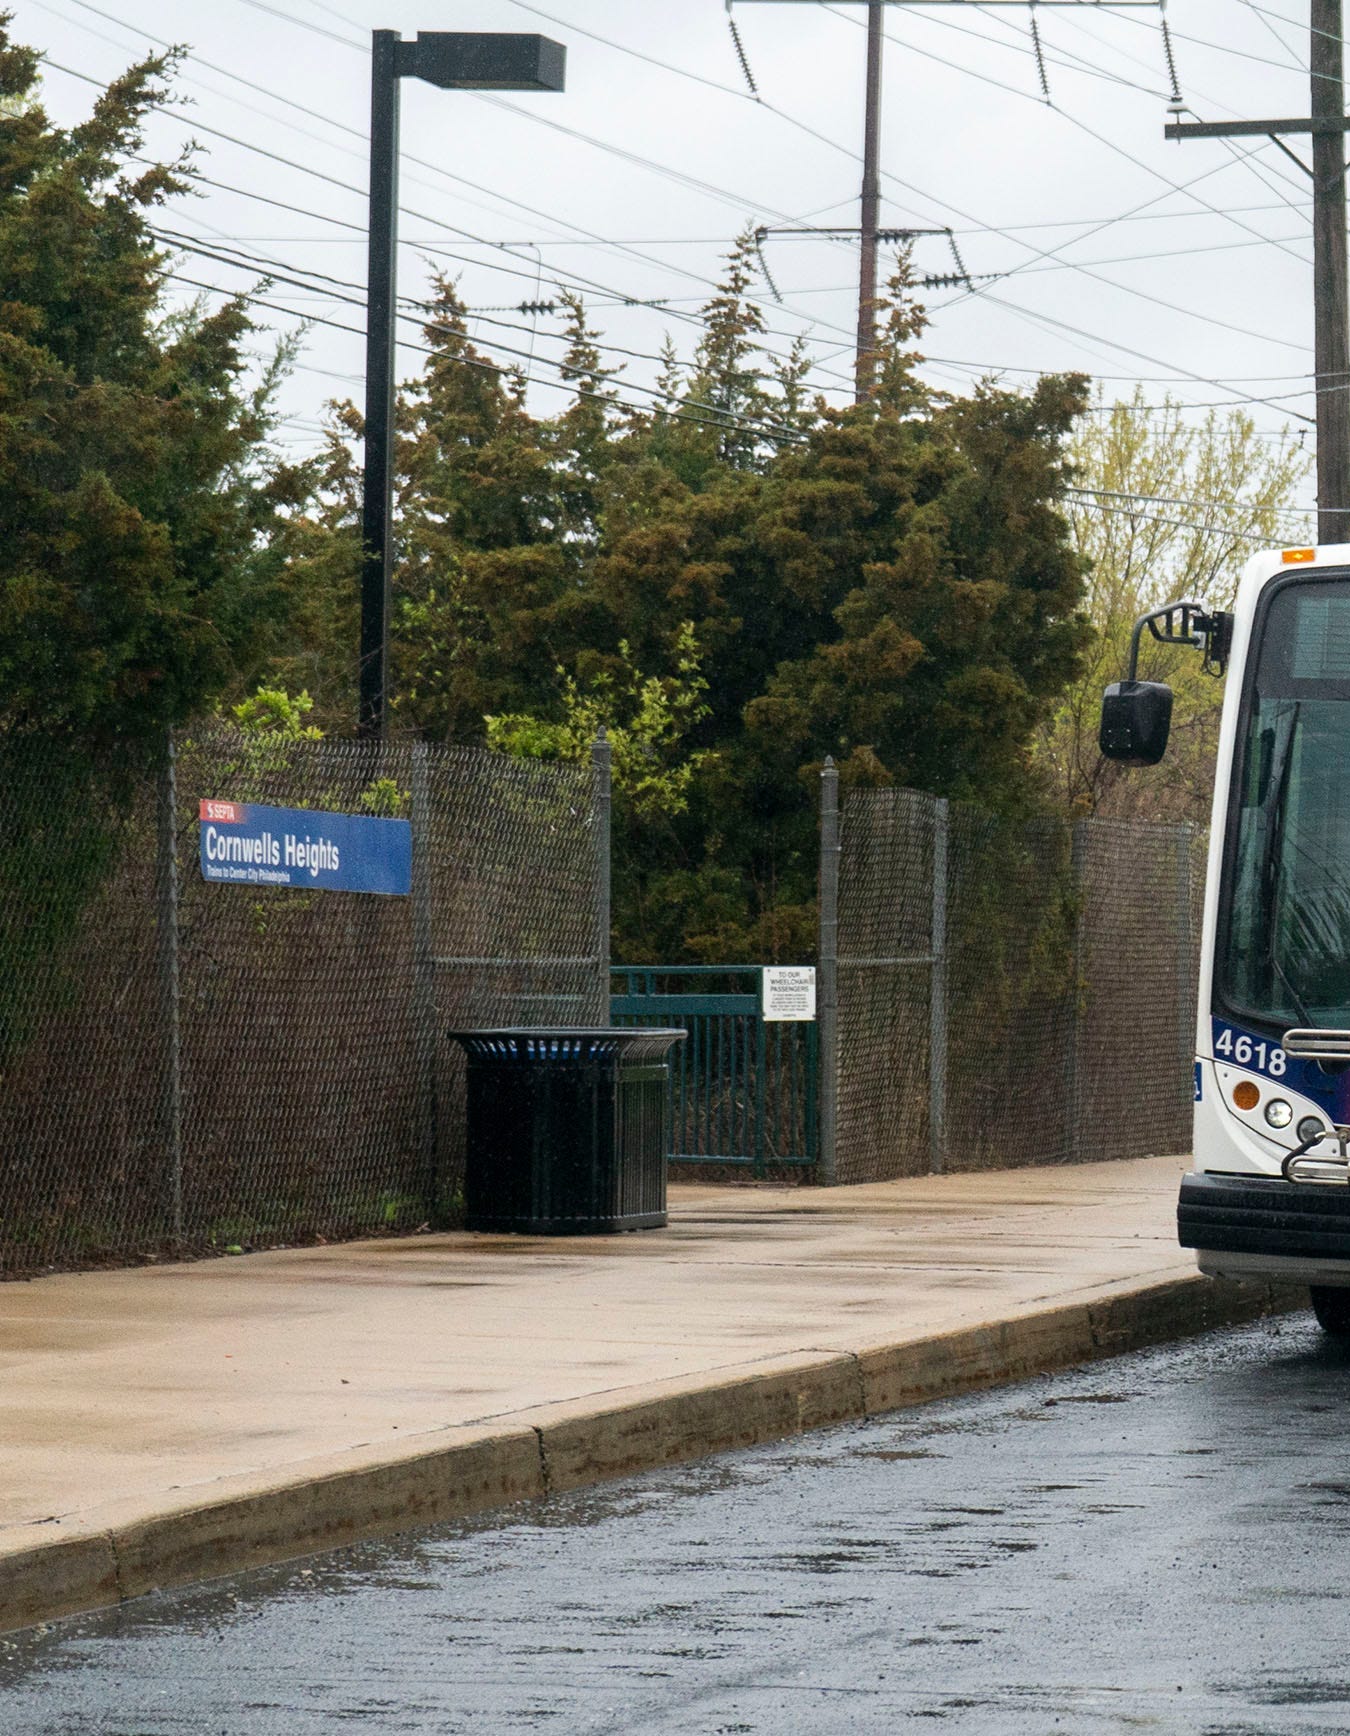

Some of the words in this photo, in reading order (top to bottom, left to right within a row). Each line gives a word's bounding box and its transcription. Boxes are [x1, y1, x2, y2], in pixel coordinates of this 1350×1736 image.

[214, 804, 234, 820] SEPTA
[206, 826, 280, 866] Cornwells
[285, 834, 339, 877] Heights
[248, 868, 258, 882] City
[1216, 1029, 1286, 1076] 4618
